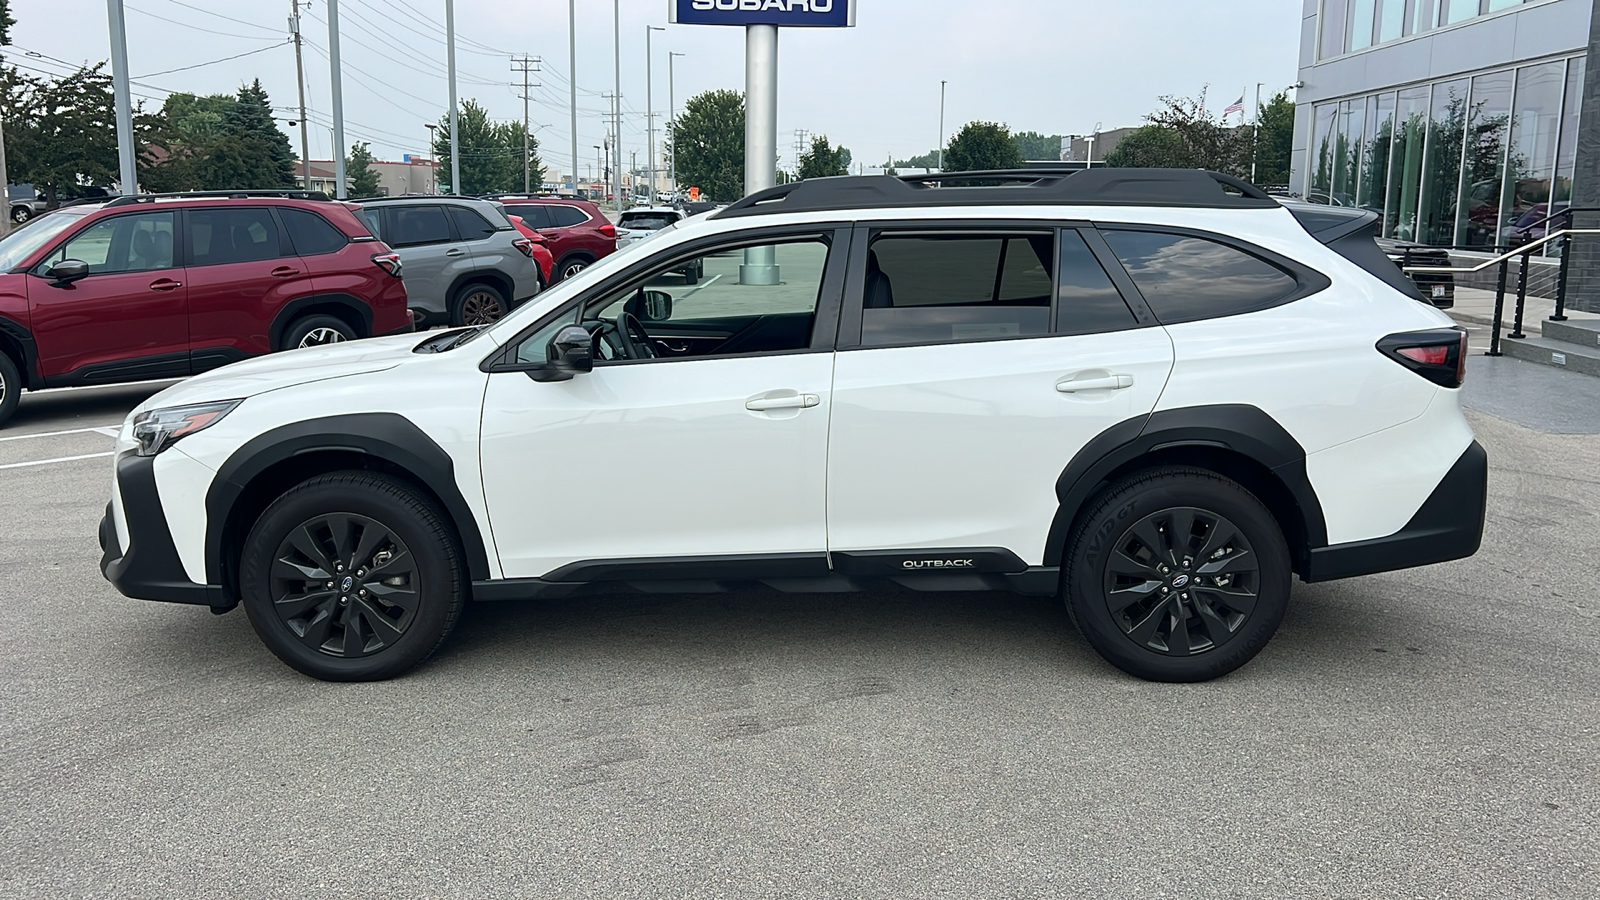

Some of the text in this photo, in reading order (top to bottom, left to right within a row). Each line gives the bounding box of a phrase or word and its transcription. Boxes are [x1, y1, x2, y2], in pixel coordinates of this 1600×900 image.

[1086, 499, 1138, 572] AVID GT
[902, 558, 973, 568] OUTBACK
